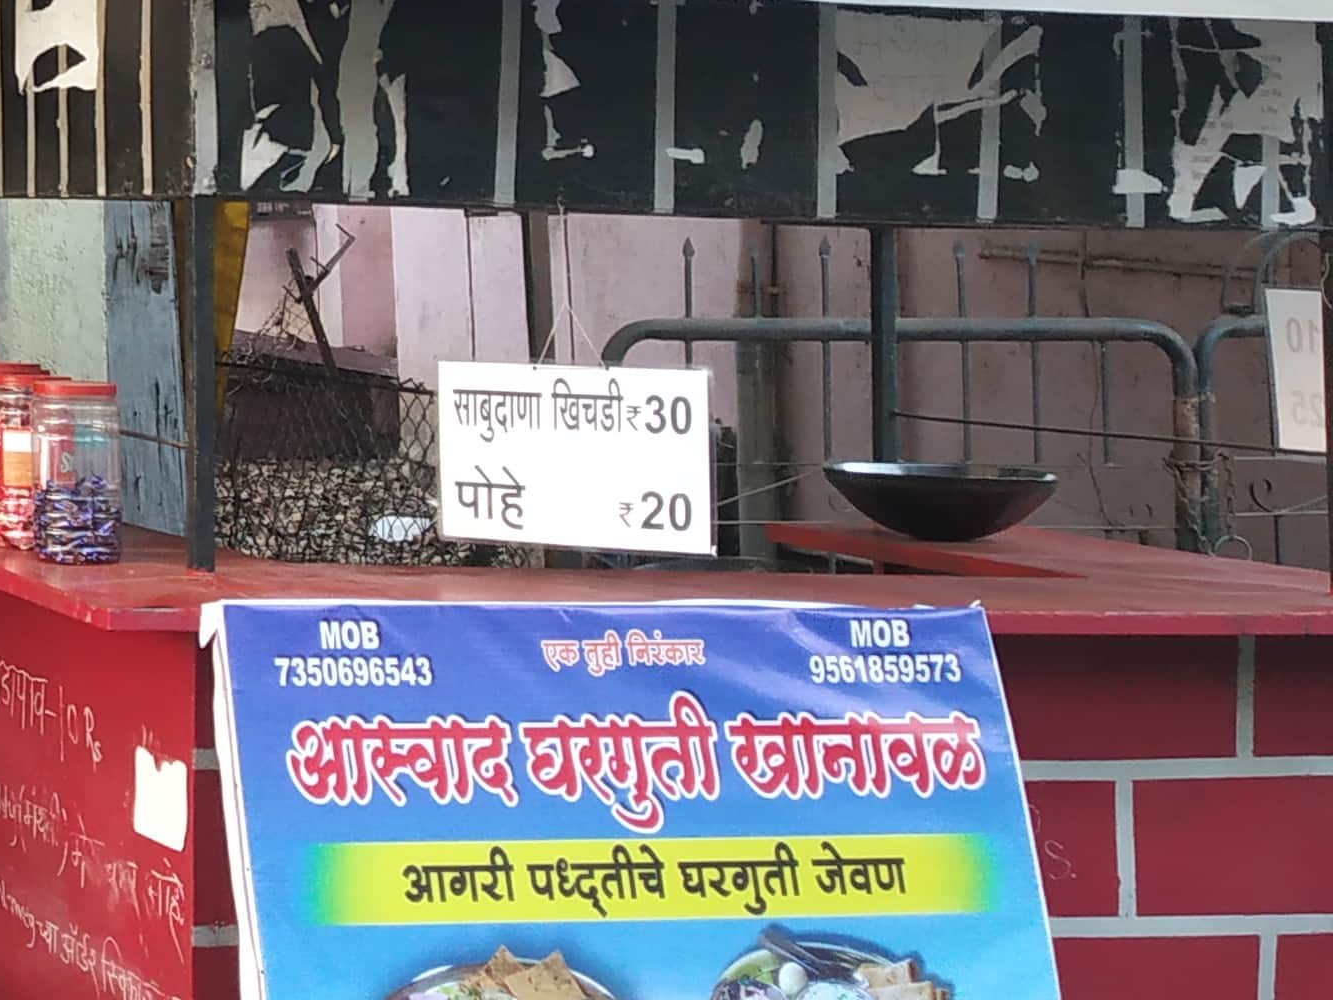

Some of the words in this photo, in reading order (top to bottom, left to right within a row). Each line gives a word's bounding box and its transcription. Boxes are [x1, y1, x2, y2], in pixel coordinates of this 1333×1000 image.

[452, 388, 543, 443] साबुदाणा
[551, 378, 624, 432] खिचडी
[454, 465, 526, 529] पोहे
[318, 620, 380, 650] MOB
[541, 639, 579, 672] एक
[626, 628, 706, 666] निरंकार
[849, 619, 911, 648] MOB
[274, 656, 433, 687] 7350696543
[808, 653, 962, 684] 9561859573
[288, 715, 516, 804] आस्वाद
[525, 692, 719, 831] घरगुती
[731, 713, 985, 799] खानावळ
[401, 845, 515, 902] आगरी
[677, 842, 802, 914] घरगुती
[812, 841, 907, 897] जेवण
